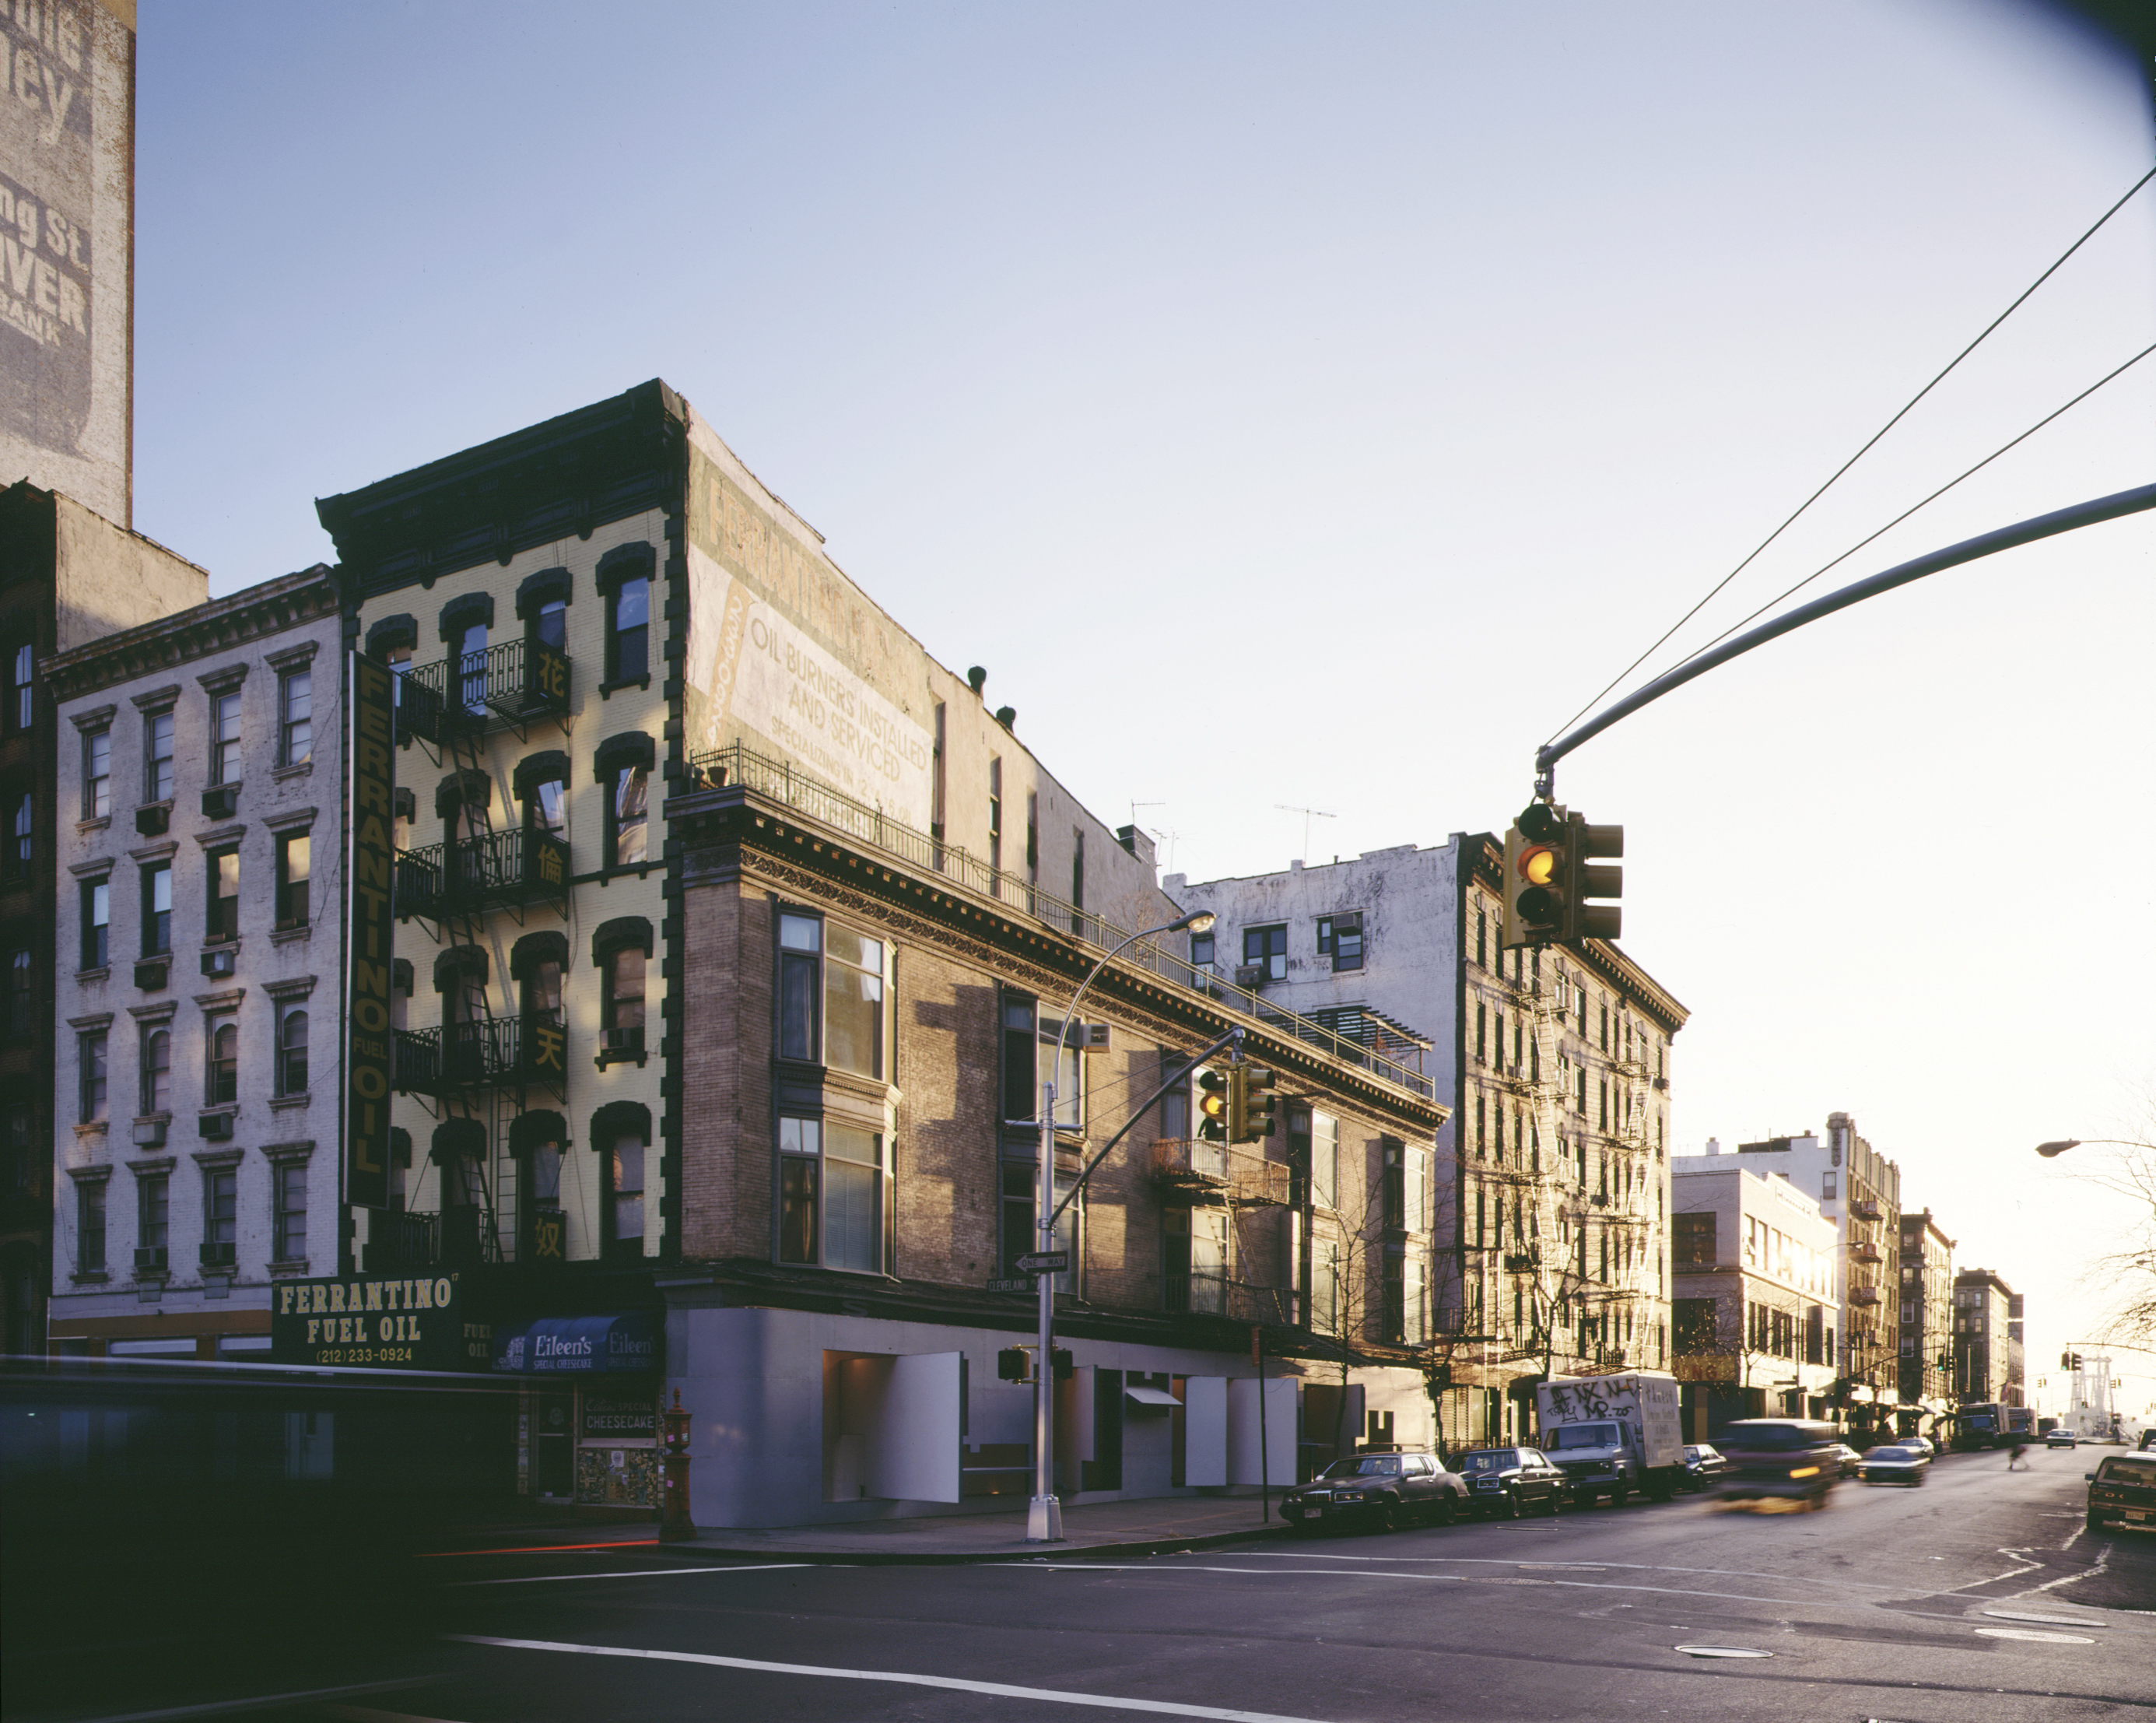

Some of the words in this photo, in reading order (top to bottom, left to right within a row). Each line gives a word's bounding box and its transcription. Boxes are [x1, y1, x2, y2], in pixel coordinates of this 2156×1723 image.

[710, 477, 846, 650] FERRANTINO
[896, 644, 923, 714] OIL
[538, 652, 565, 698] 花
[751, 617, 782, 665] OIL
[787, 640, 854, 718] BURNERS
[860, 697, 927, 772] INSTALLED
[788, 682, 826, 730] AND
[830, 711, 900, 782] SERVICED
[771, 714, 840, 780] SPECIALIZING
[843, 766, 854, 788] IN
[356, 662, 389, 1033] FERRANTINO
[352, 1036, 387, 1060] FUEL
[535, 1026, 563, 1072] 天
[352, 1065, 387, 1174] OIL
[1022, 1258, 1038, 1268] ONE
[1047, 1257, 1064, 1266] WAY
[281, 1277, 451, 1314] FERRANTINO
[987, 1279, 1027, 1293] CLEVELAND
[307, 1318, 367, 1343] FUEL
[380, 1315, 421, 1342] OIL
[464, 1323, 493, 1339] FUEL
[468, 1342, 489, 1358] OIL
[535, 1335, 592, 1356] Eileen's
[533, 1360, 556, 1370] SPECIAL
[557, 1358, 592, 1369] CHEESECAKE
[618, 1402, 653, 1412] SPECIAL
[587, 1415, 655, 1429] CHEESECAKE
